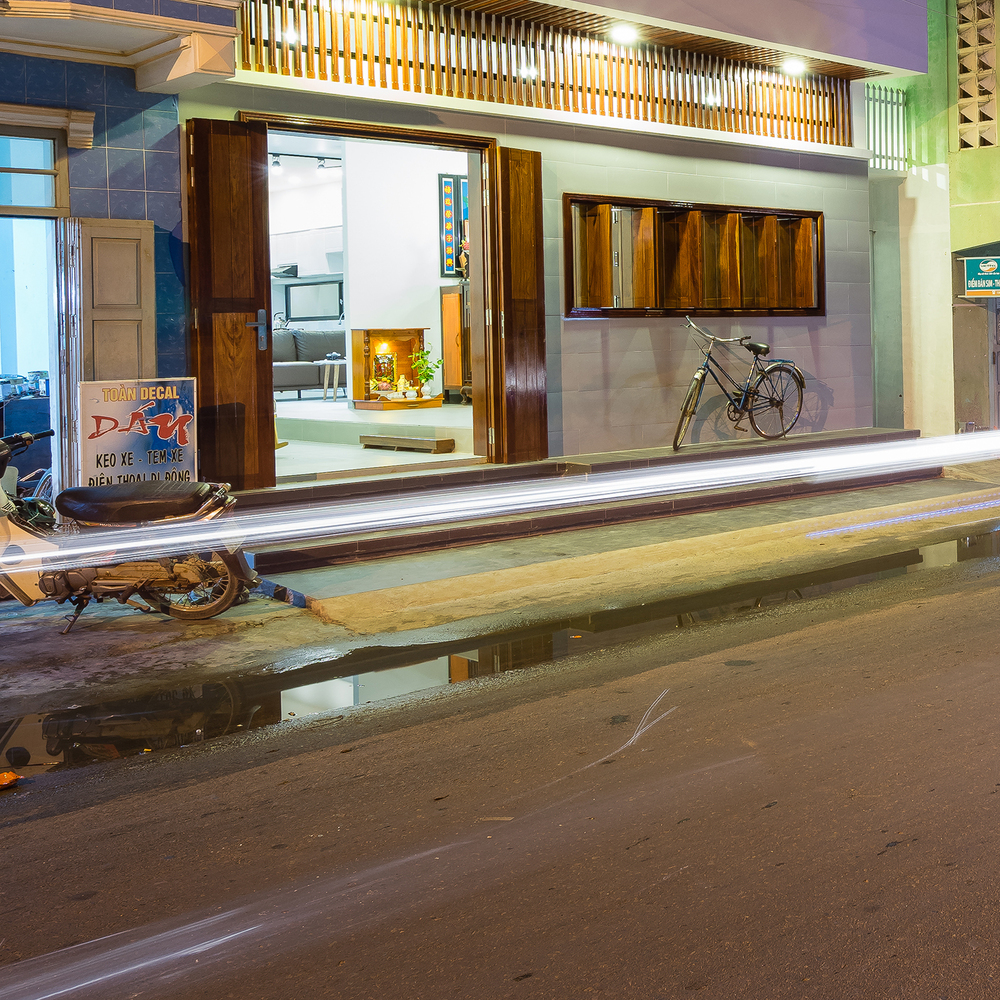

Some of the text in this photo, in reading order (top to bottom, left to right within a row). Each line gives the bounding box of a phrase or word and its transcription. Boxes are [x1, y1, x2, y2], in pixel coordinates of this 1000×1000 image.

[140, 385, 180, 401] DECAL
[96, 453, 116, 469] KEO
[121, 452, 134, 467] XE
[147, 449, 167, 465] TEM
[171, 448, 184, 462] XE
